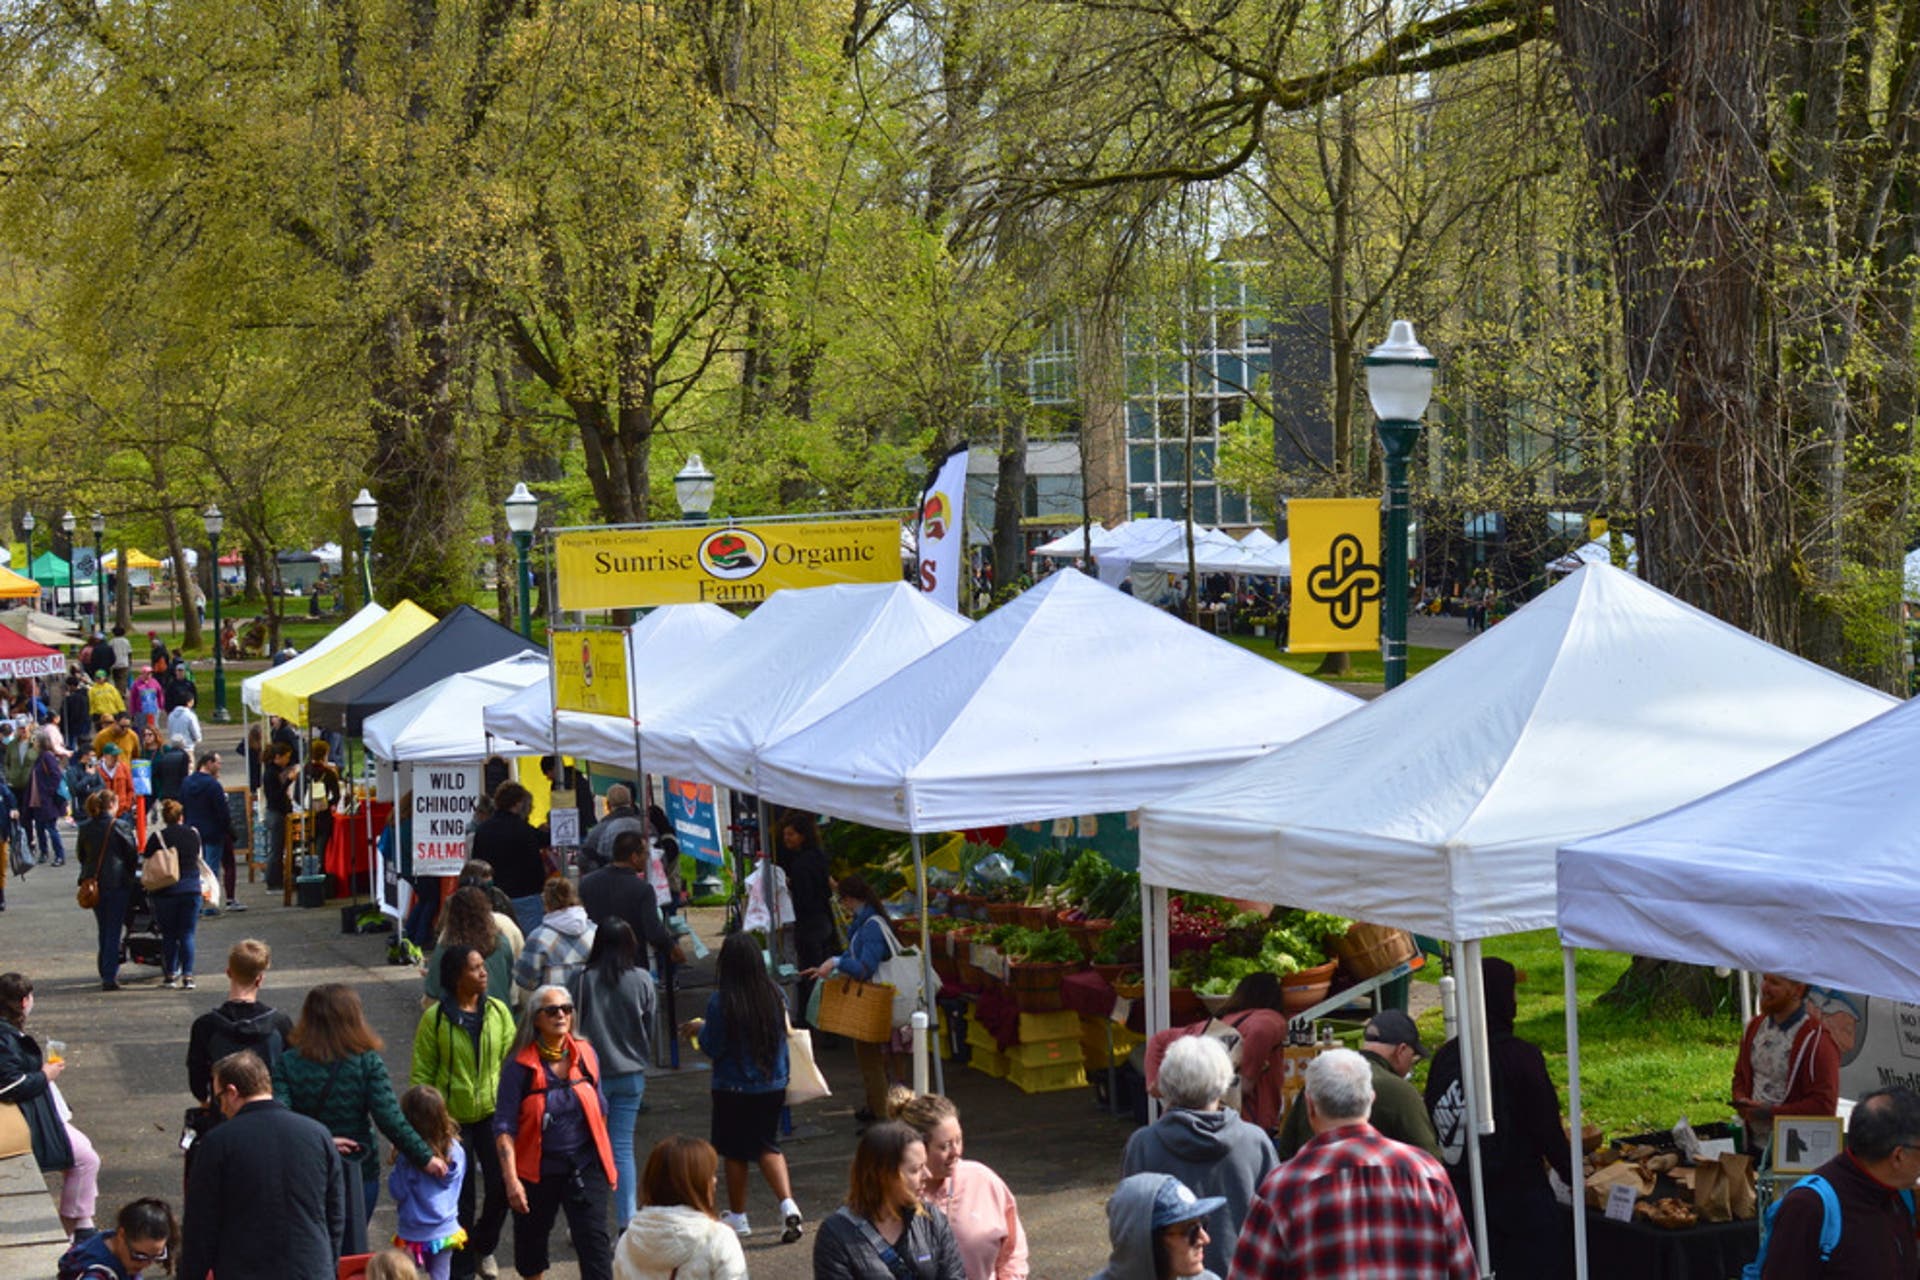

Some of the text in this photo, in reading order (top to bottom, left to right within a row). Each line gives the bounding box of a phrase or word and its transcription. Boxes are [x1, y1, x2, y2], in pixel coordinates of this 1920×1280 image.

[595, 540, 874, 574] Sunrise Organic
[699, 580, 765, 602] Farm
[16, 657, 49, 675] EGGS
[430, 773, 465, 790] WILD
[416, 796, 477, 813] CHINOOK
[430, 819, 464, 836] KING
[417, 842, 466, 860] SALMO
